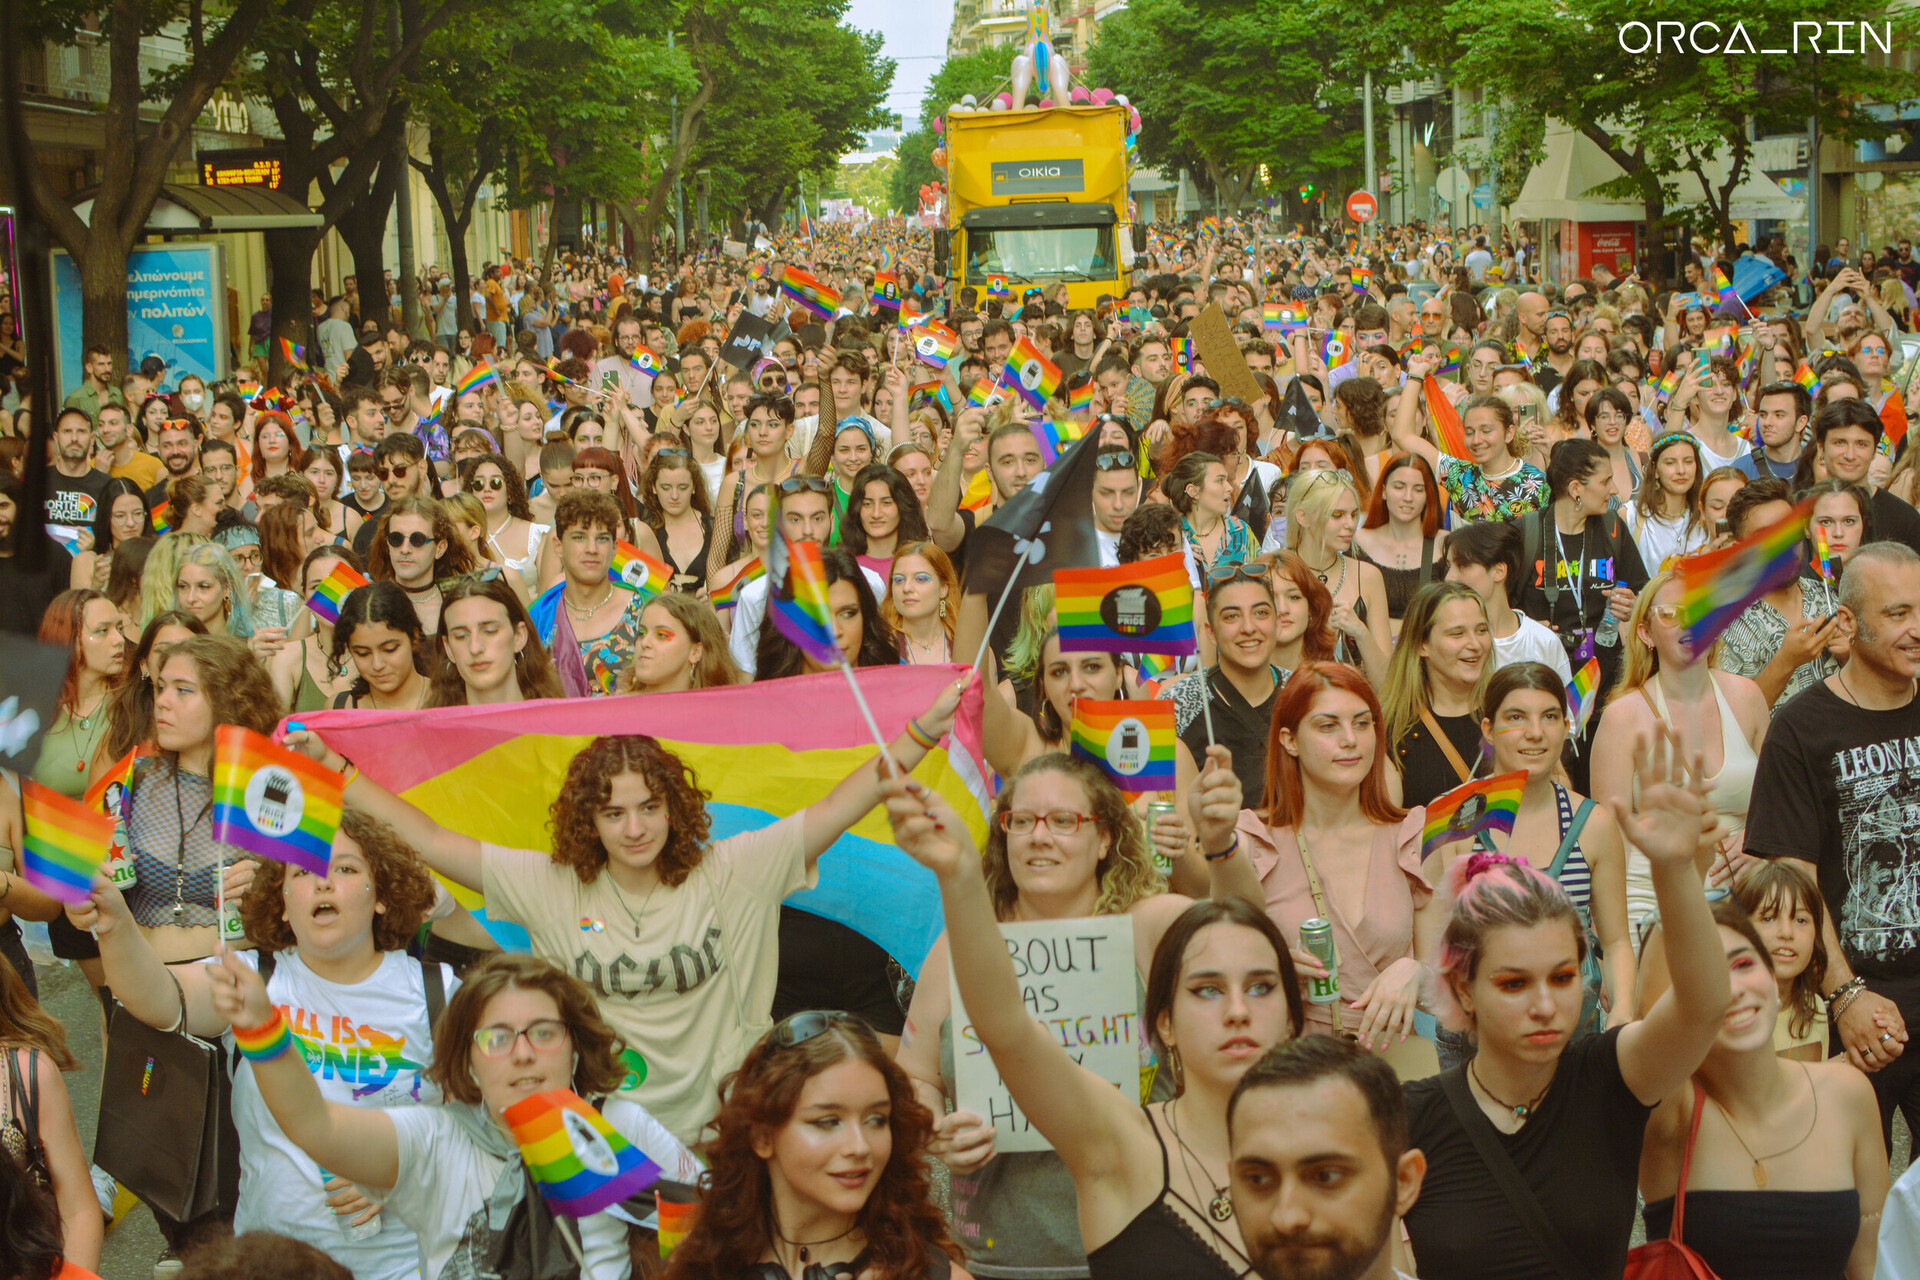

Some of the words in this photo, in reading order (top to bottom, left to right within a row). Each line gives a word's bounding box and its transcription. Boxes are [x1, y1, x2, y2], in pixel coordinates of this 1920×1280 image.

[127, 269, 204, 284] ελτιώνουμε
[126, 285, 205, 302] ημερινότητα
[141, 302, 206, 319] πολιτών
[56, 491, 79, 502] THE
[50, 510, 78, 521] FACE
[1117, 616, 1146, 626] PRIDE
[1834, 735, 1920, 782] LEONA
[1004, 936, 1108, 978] BOUT
[331, 1015, 357, 1045] IS
[961, 1012, 1137, 1056] SIGHT
